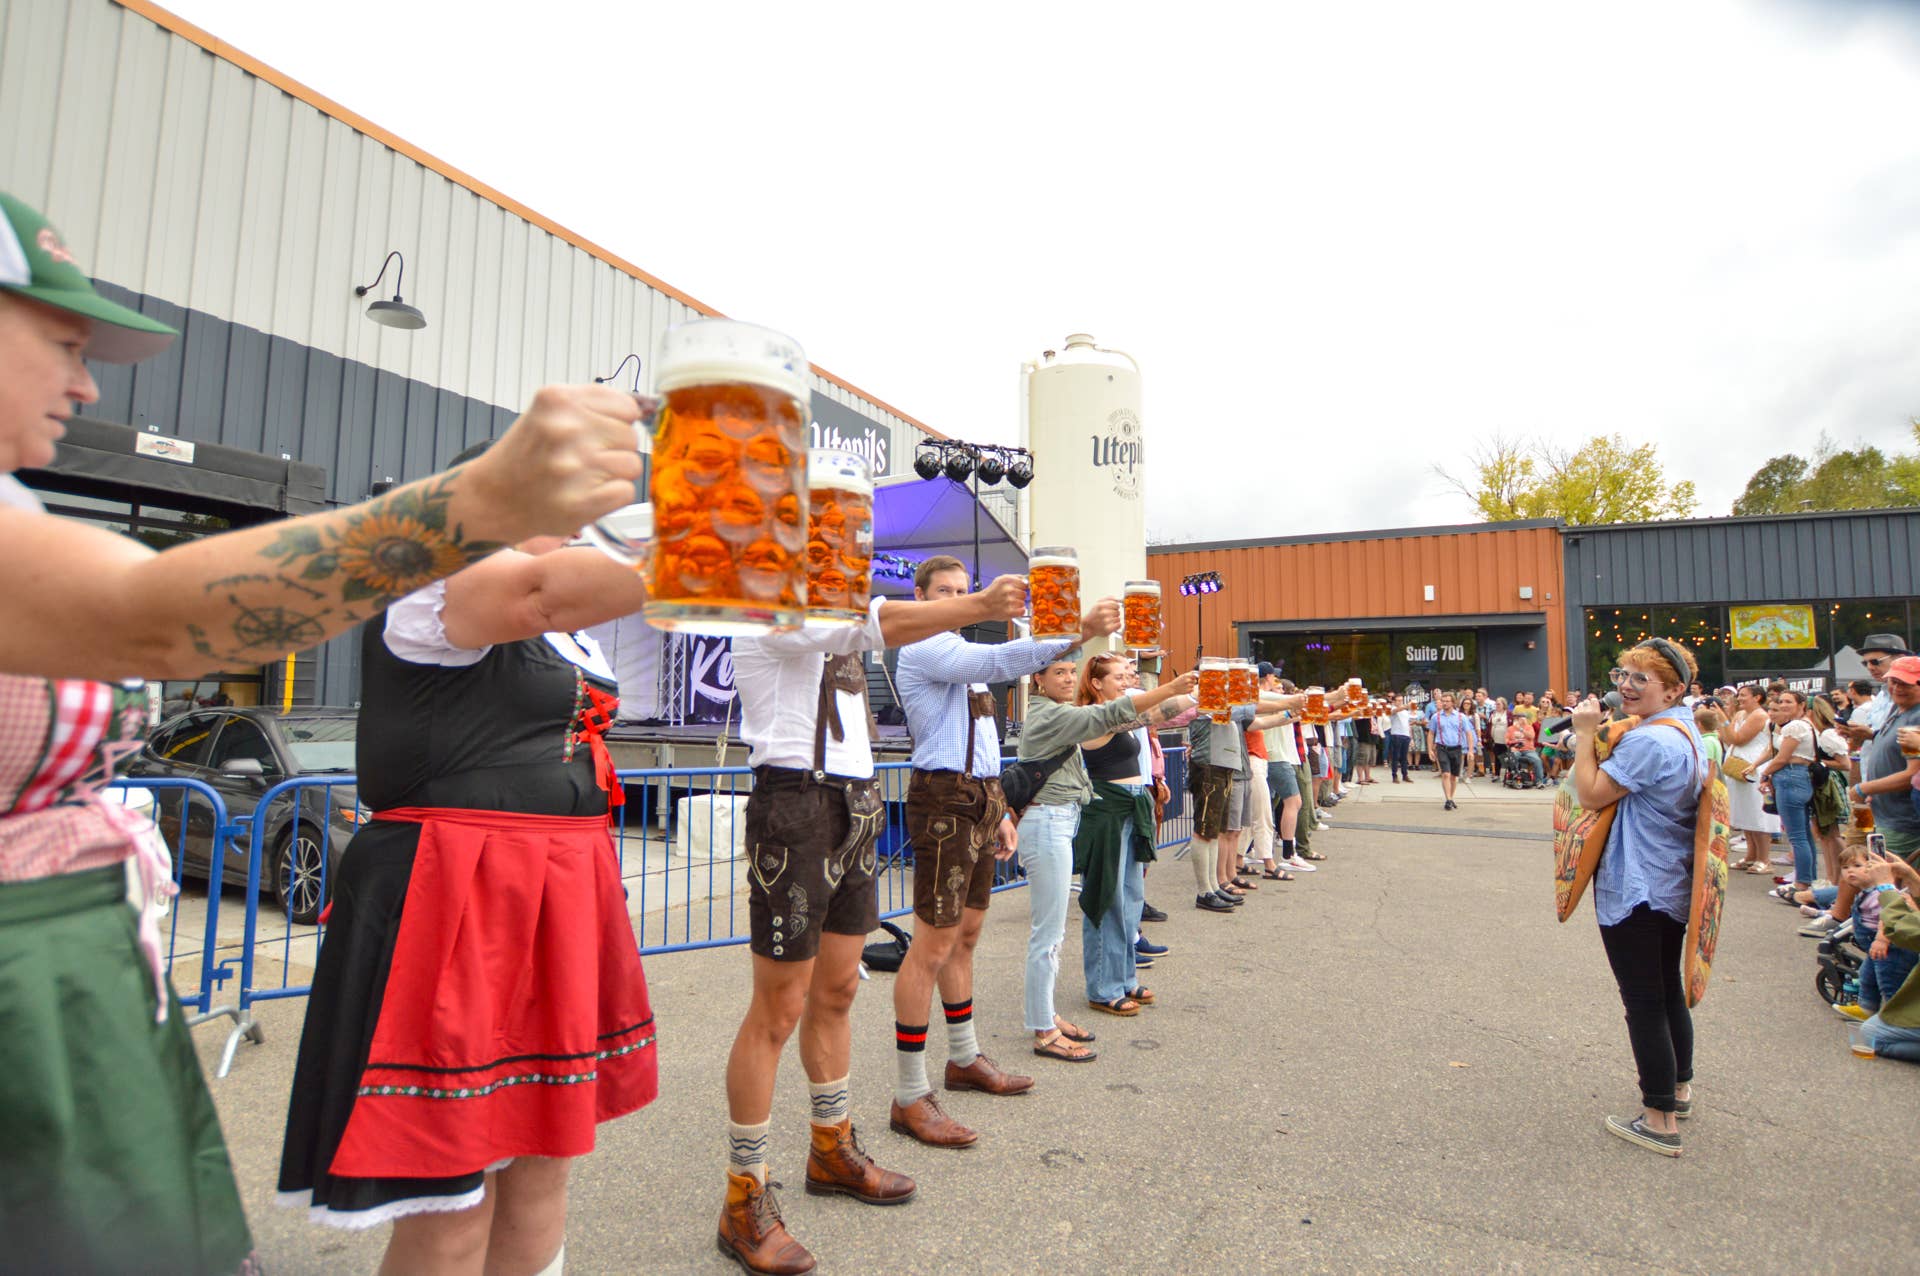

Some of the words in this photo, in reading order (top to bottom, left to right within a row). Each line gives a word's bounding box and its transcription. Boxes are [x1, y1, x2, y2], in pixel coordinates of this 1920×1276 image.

[1092, 435, 1144, 474] Utepil
[1406, 645, 1438, 661] Suite
[1440, 644, 1464, 661] 700
